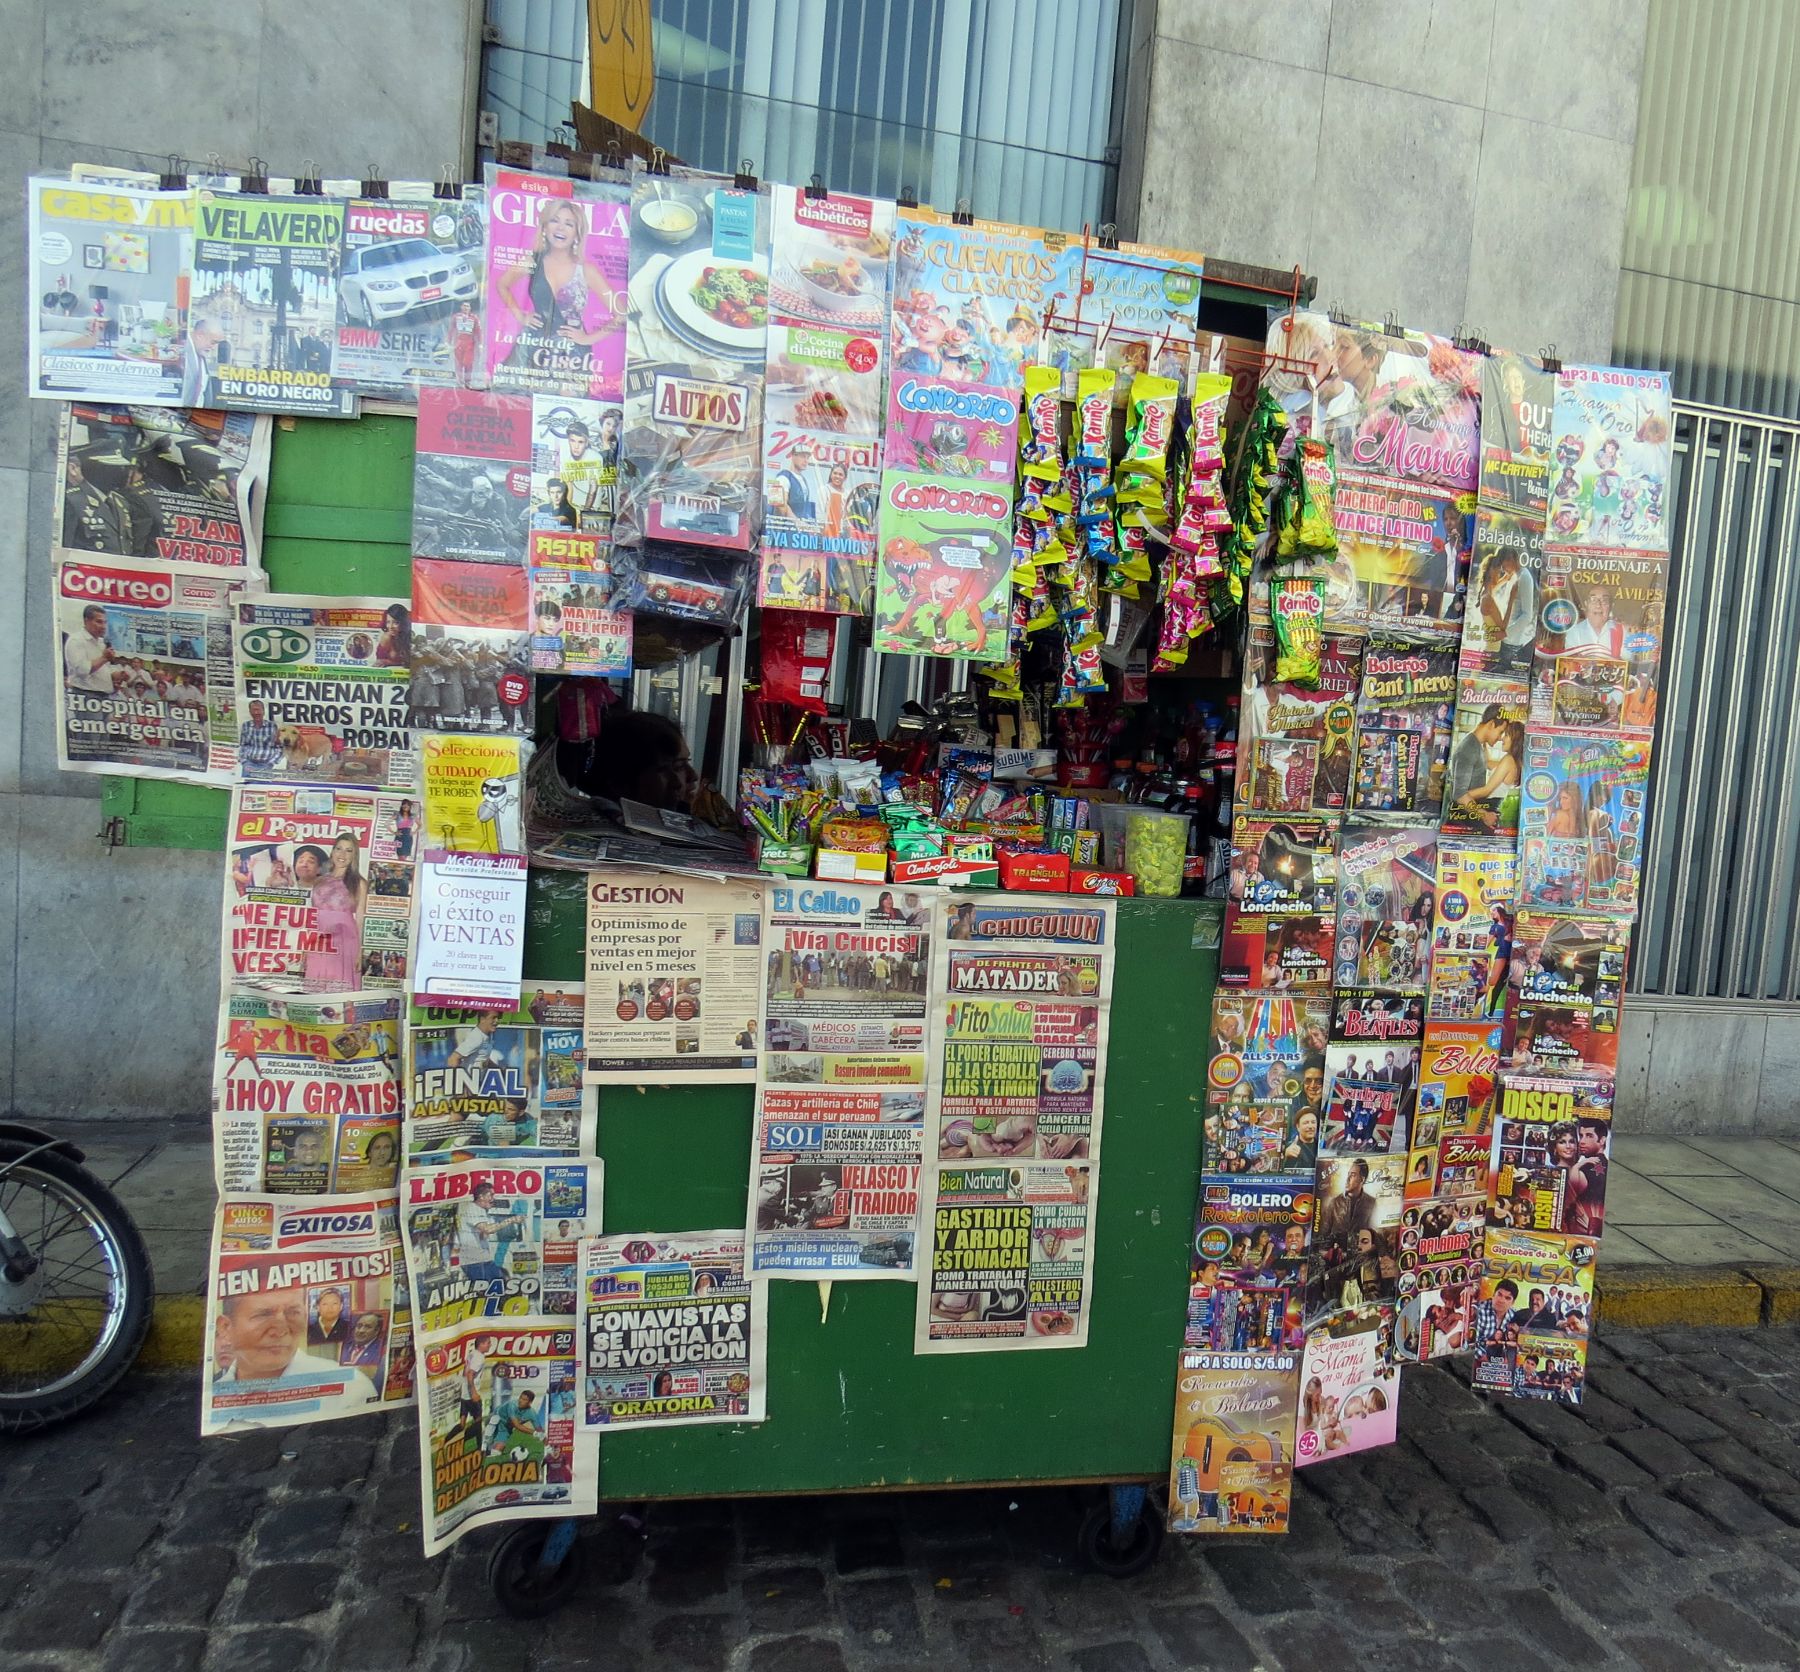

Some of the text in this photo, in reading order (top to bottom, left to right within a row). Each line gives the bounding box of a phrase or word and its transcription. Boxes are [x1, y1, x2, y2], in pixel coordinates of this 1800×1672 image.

[721, 207, 747, 217] PASTAS
[798, 208, 868, 229] diabéticos
[350, 213, 425, 235] ruedas
[929, 241, 1057, 283] CUENTOS
[942, 276, 1044, 302] CLASICOS
[810, 336, 844, 349] Cocina
[43, 356, 160, 377] Clásicos modernos
[533, 348, 604, 373] Gisela
[217, 365, 331, 388] EMBARRADO
[221, 382, 333, 401] EN ORO NEGRO
[659, 382, 742, 425] AUTOS
[899, 381, 1016, 425] CONDORITO
[1353, 415, 1471, 479] Mamá
[890, 480, 1009, 521] CONDORITO
[174, 515, 241, 545] PLAN
[156, 537, 243, 567] VERDE
[1519, 552, 1541, 569] Oro
[1577, 559, 1663, 575] HOMENAJE A
[62, 569, 171, 602] Correo
[1572, 571, 1621, 586] OSCAR
[183, 588, 217, 599] Correo
[1278, 592, 1321, 616] Karinto
[242, 629, 310, 660] ojo
[1366, 655, 1428, 674] Boleros
[506, 681, 523, 690] DVD
[1462, 688, 1528, 704] Baladas en
[67, 693, 200, 723] Hospital en
[69, 718, 205, 744] emergencia
[426, 739, 517, 759] Selecciones
[996, 752, 1035, 770] SUBLIME
[428, 765, 491, 778] CUIDADO:
[428, 777, 475, 789] no dejes que
[989, 827, 1020, 836] Trident
[446, 854, 520, 870] McGraw-Hill
[438, 883, 511, 903] Conseguir
[592, 883, 684, 904] GESTIÓN
[773, 889, 861, 914] El Callao
[429, 902, 516, 924] el éxito en
[1240, 900, 1313, 913] Lonchecito
[274, 906, 318, 929] FUE
[591, 918, 688, 932] Optimismo de
[428, 923, 515, 946] VENTAS
[979, 915, 1101, 943] CHUCULUN
[591, 935, 682, 946] empresas por
[785, 930, 918, 953] ¡Vía Crucis!
[591, 947, 697, 961] ventas en mejor
[1281, 959, 1327, 967] Lonchecito
[591, 961, 697, 972] nivel en 5 meses
[995, 960, 1031, 969] FRENTE
[1519, 989, 1593, 1005] Lonchecito
[1374, 1010, 1389, 1019] THE
[1344, 1010, 1419, 1039] BEATLES
[548, 1036, 578, 1049] HOY
[811, 1035, 856, 1044] CABECERA
[1034, 1035, 1076, 1044] GRASA
[945, 1045, 1040, 1062] EL PODER CURATIVO
[1043, 1047, 1096, 1059] CEREBRO SANO
[1241, 1052, 1301, 1061] ALL-STARS
[1532, 1045, 1579, 1056] Lonchecito
[414, 1068, 527, 1103] ¡FINAL
[764, 1097, 879, 1110] Cazas y artilleria de Chile
[942, 1107, 1036, 1115] ARTROSIS Y OSTEOPOROSIS
[1502, 1089, 1574, 1122] DISCO
[763, 1111, 876, 1123] amenazan el sur peruano
[770, 1126, 821, 1146] SOL
[1037, 1125, 1091, 1134] CUELLO UTERINO
[842, 1166, 920, 1190] VELASCO Y
[939, 1169, 1005, 1191] Bien Natural
[834, 1191, 850, 1216] EL
[854, 1191, 917, 1215] TRAIDOR
[1034, 1205, 1087, 1217] COMO CUIDAR
[231, 1209, 268, 1218] CINCO
[936, 1207, 1032, 1229] GASTRITIS
[1313, 1198, 1321, 1233] Original
[280, 1214, 374, 1235] EXITOSA
[756, 1242, 863, 1254] ¡Estos misiles nucleares
[937, 1228, 1028, 1250] Y ARDOR
[1419, 1233, 1470, 1255] BALADAS
[759, 1254, 859, 1267] pueden arrasar EEUU!
[933, 1248, 1029, 1270] ESTOMACAL
[1491, 1244, 1559, 1260] Gigantes de la
[219, 1251, 391, 1297] ¡EN APRIETOS!
[936, 1269, 1027, 1281] COMO TRATARLA DE
[1486, 1259, 1577, 1287] SALSA
[935, 1279, 1026, 1290] MANERA NATURAL
[1029, 1280, 1082, 1291] COLESTEROL
[1029, 1290, 1080, 1303] ALTO
[590, 1303, 747, 1333] FONAVISTAS
[555, 1334, 571, 1343] 20
[593, 1323, 744, 1351] SE INICIA LA
[590, 1341, 746, 1368] DEVOLUCION
[1184, 1355, 1293, 1371] MP3 A SOLO S/5.00
[509, 1366, 527, 1378] 1-1
[612, 1395, 715, 1415] ORATORIA
[436, 1452, 482, 1490] PUNTO
